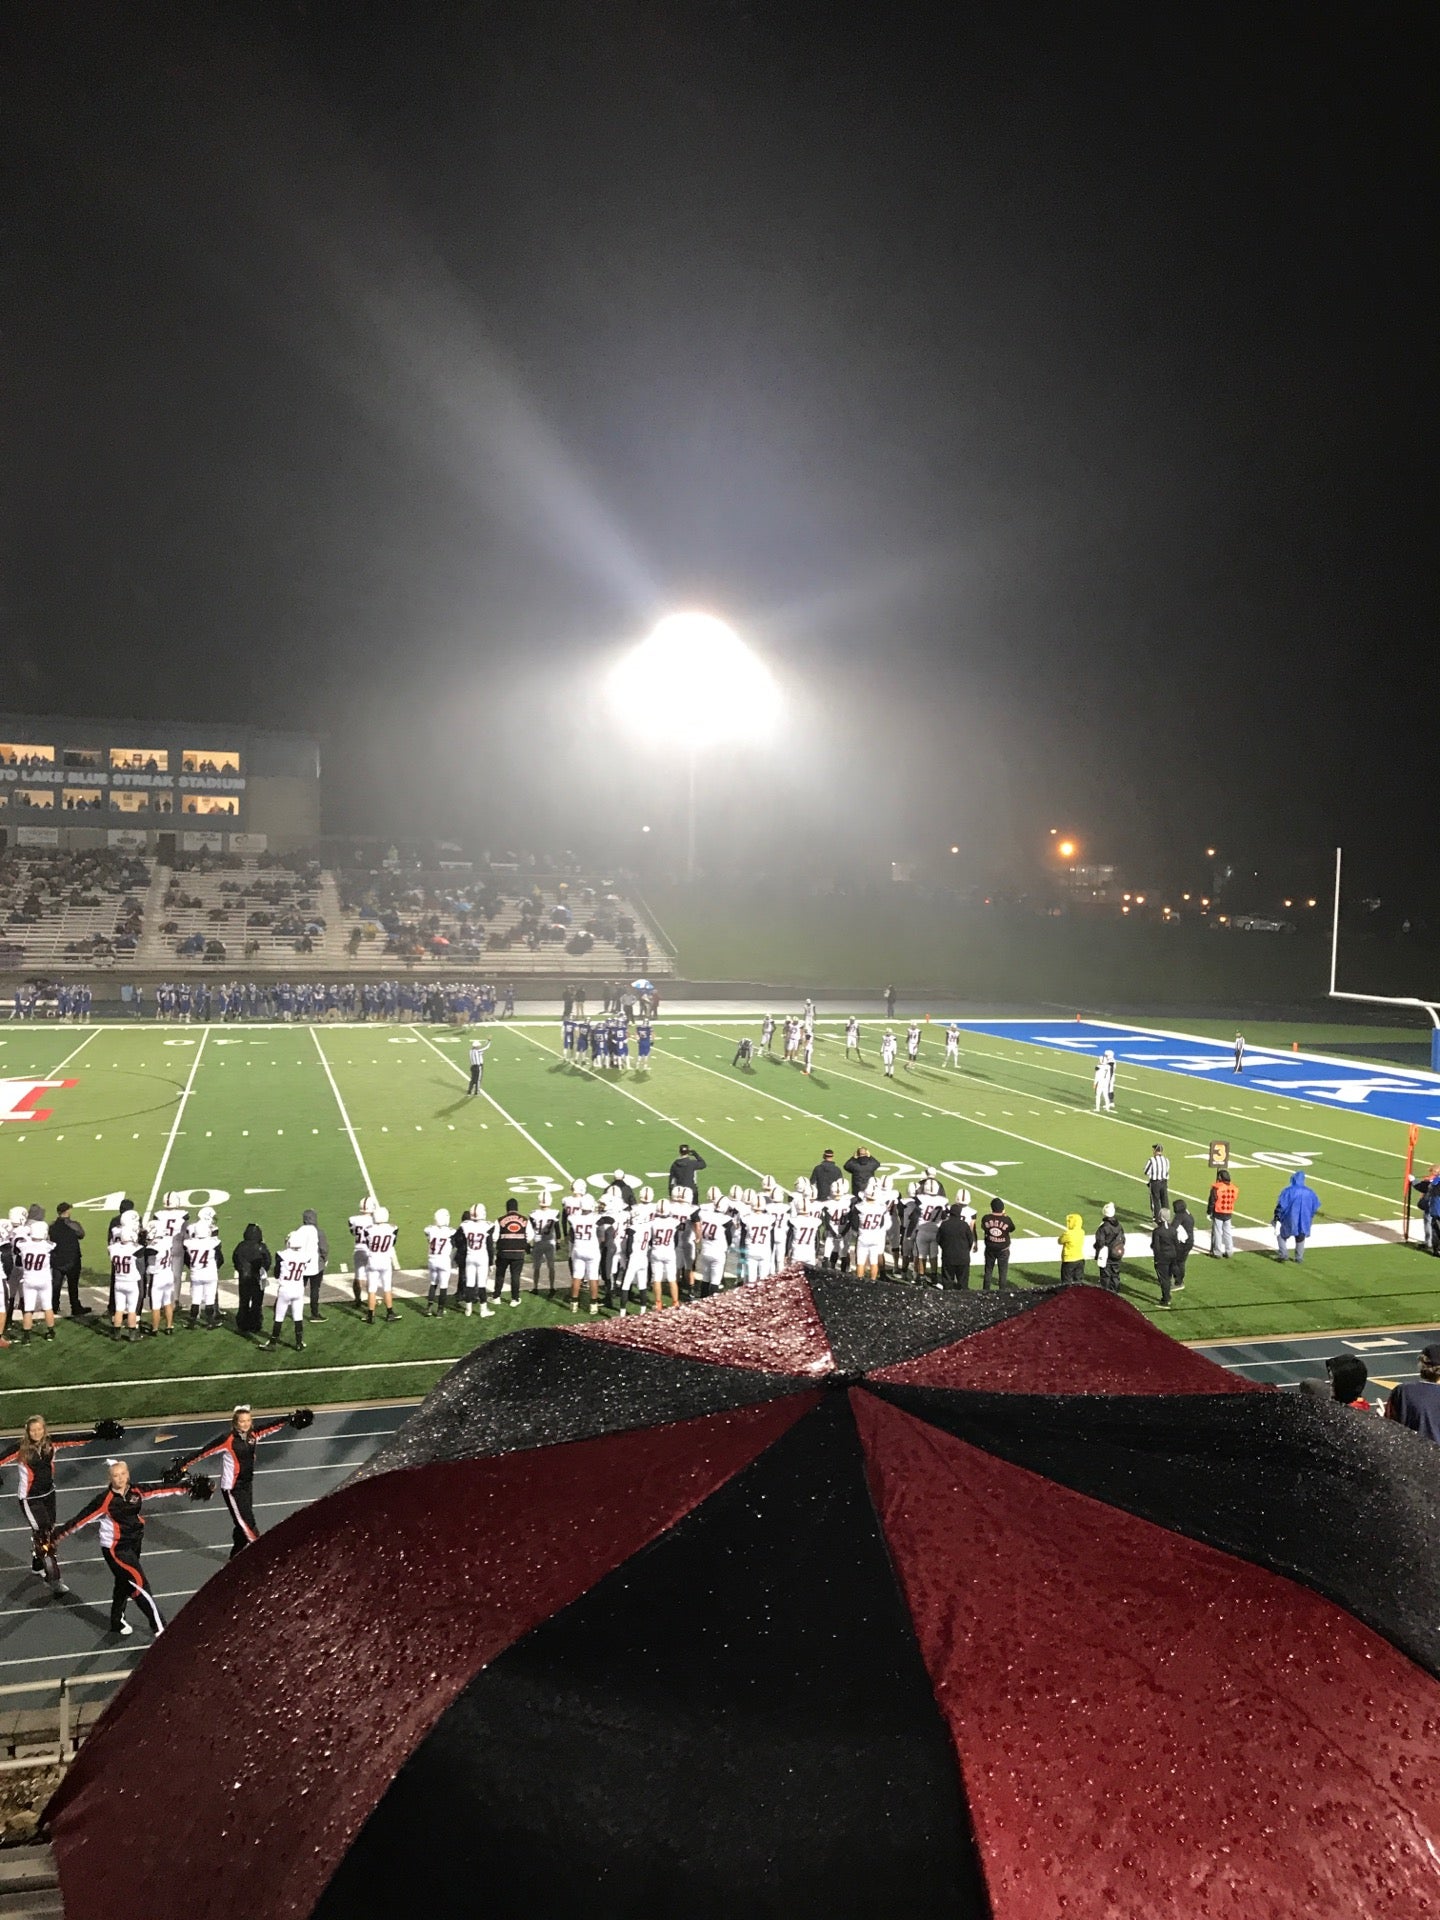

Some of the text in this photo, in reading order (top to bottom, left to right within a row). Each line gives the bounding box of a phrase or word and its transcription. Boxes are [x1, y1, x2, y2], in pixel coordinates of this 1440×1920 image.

[21, 769, 64, 783] LAKE
[67, 771, 108, 785] BLUE
[112, 773, 174, 788] STREAK
[178, 775, 246, 790] STADIUM
[1213, 1144, 1226, 1162] 3
[165, 1218, 177, 1237] 5
[863, 1213, 881, 1230] 65
[574, 1224, 593, 1241] 55
[750, 1226, 769, 1245] 75
[797, 1227, 815, 1245] 71
[371, 1235, 392, 1253] 80
[429, 1237, 447, 1255] 47
[24, 1253, 46, 1271] 88
[190, 1249, 210, 1269] 74
[283, 1261, 306, 1281] 36
